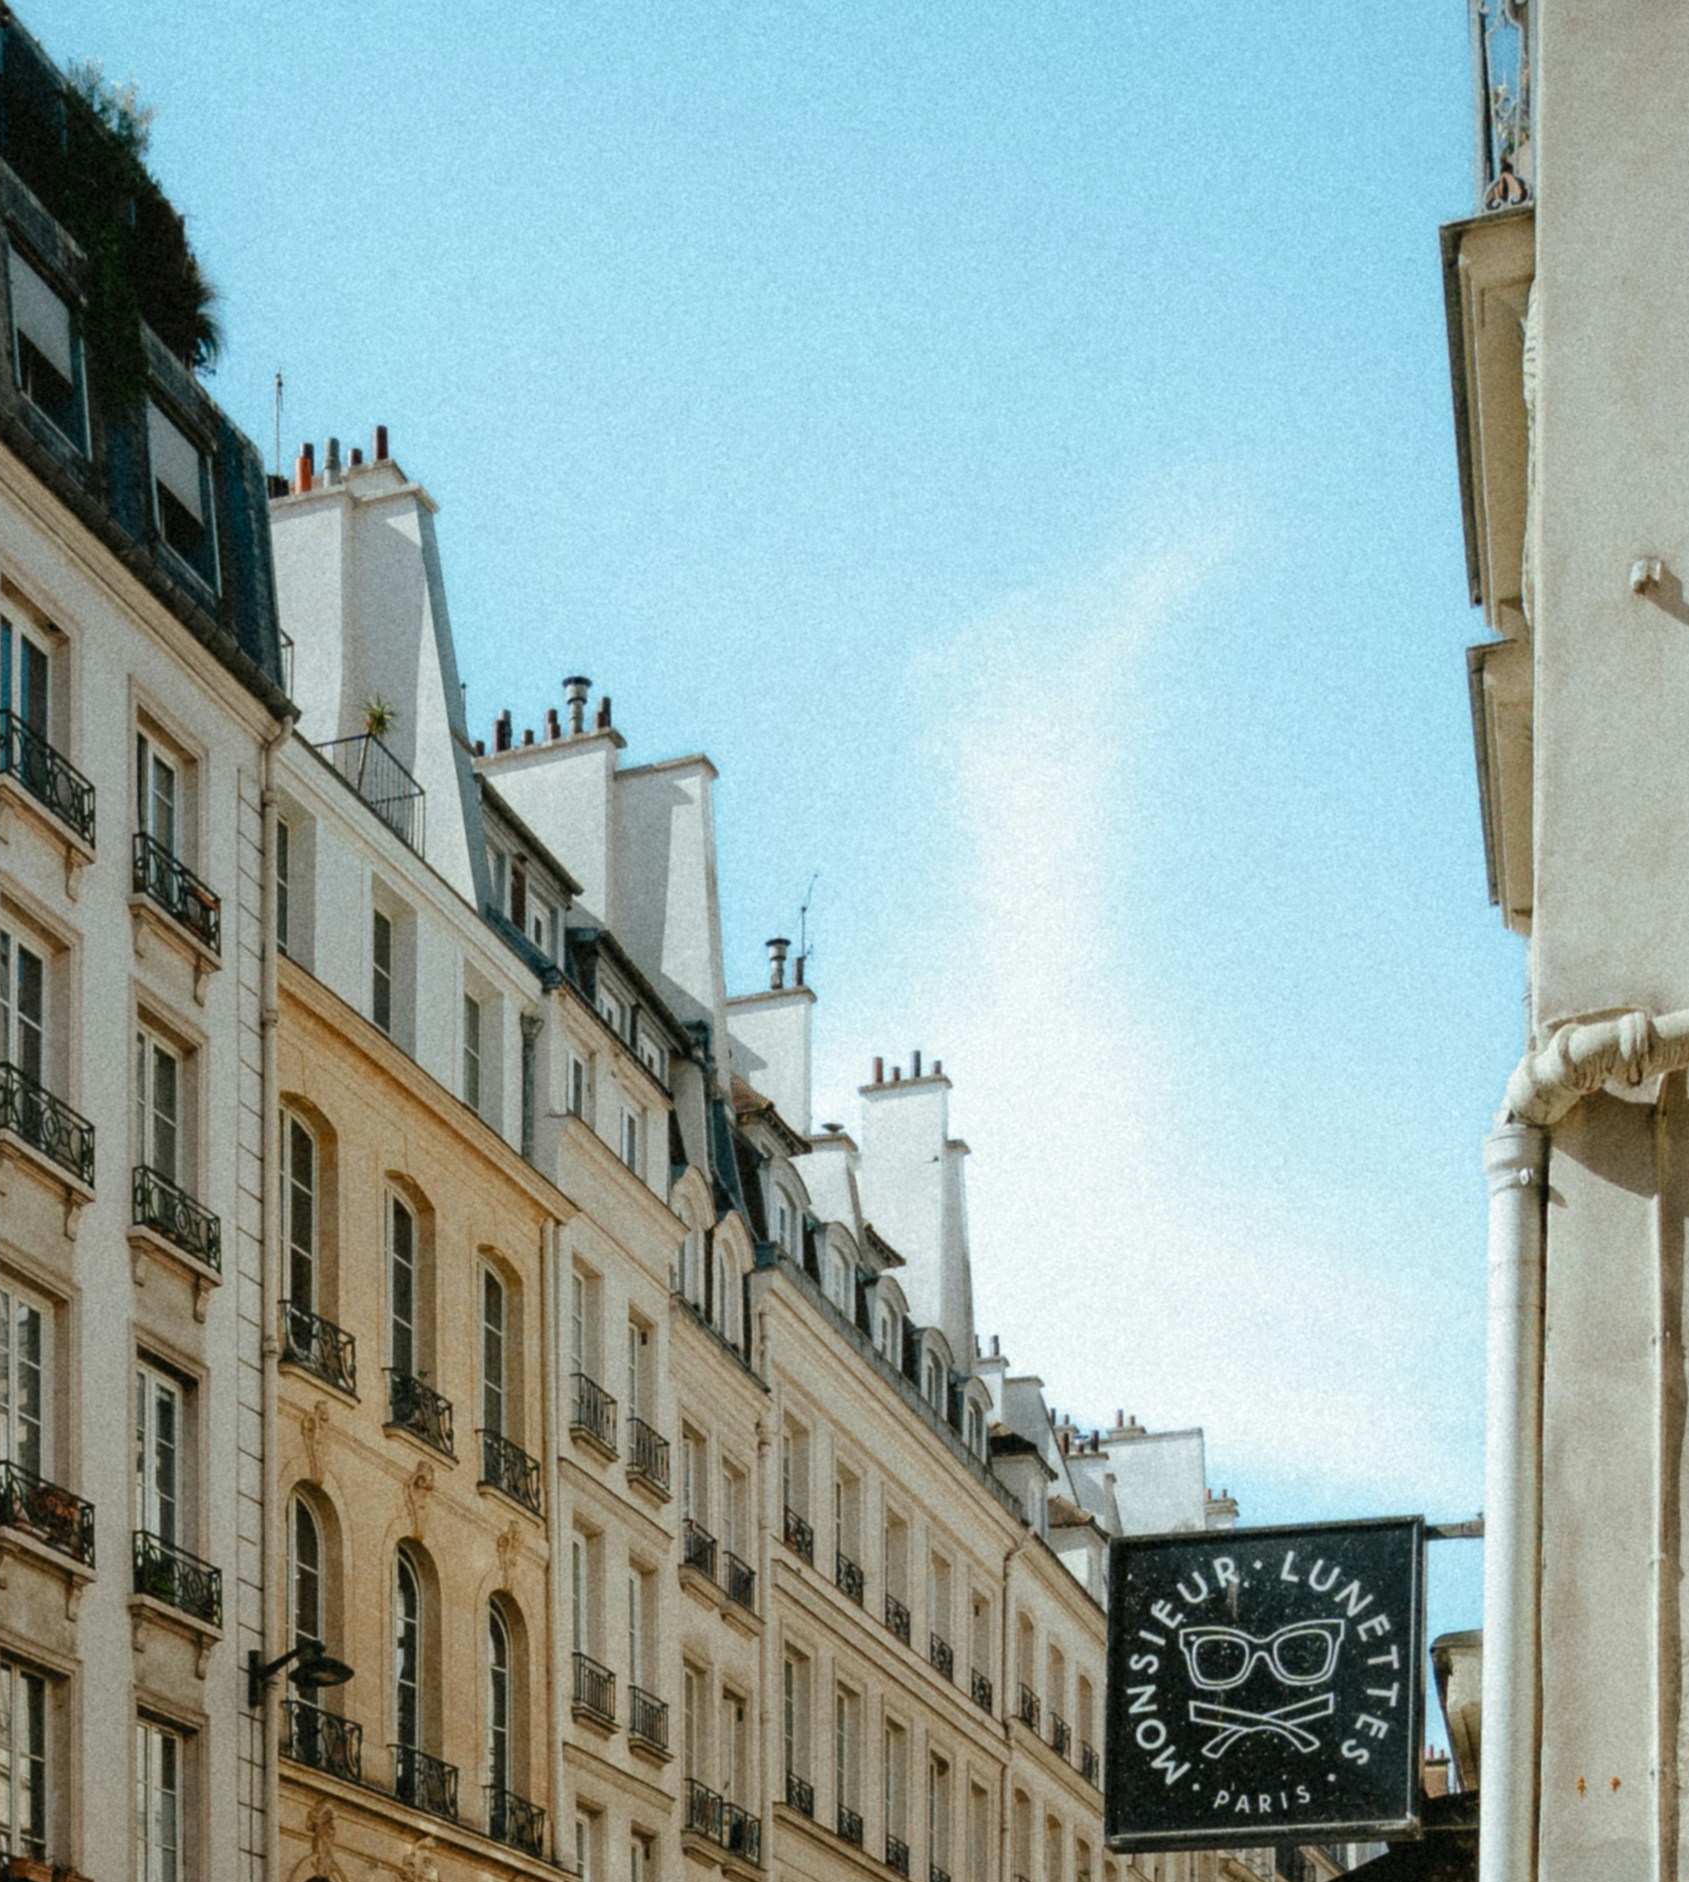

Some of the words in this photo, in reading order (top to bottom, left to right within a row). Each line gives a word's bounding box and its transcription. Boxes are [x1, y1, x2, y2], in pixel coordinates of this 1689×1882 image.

[1125, 1556, 1242, 1786] MONSIEUR
[1279, 1550, 1400, 1767] LUNETTES
[1213, 1784, 1311, 1814] PARIS
